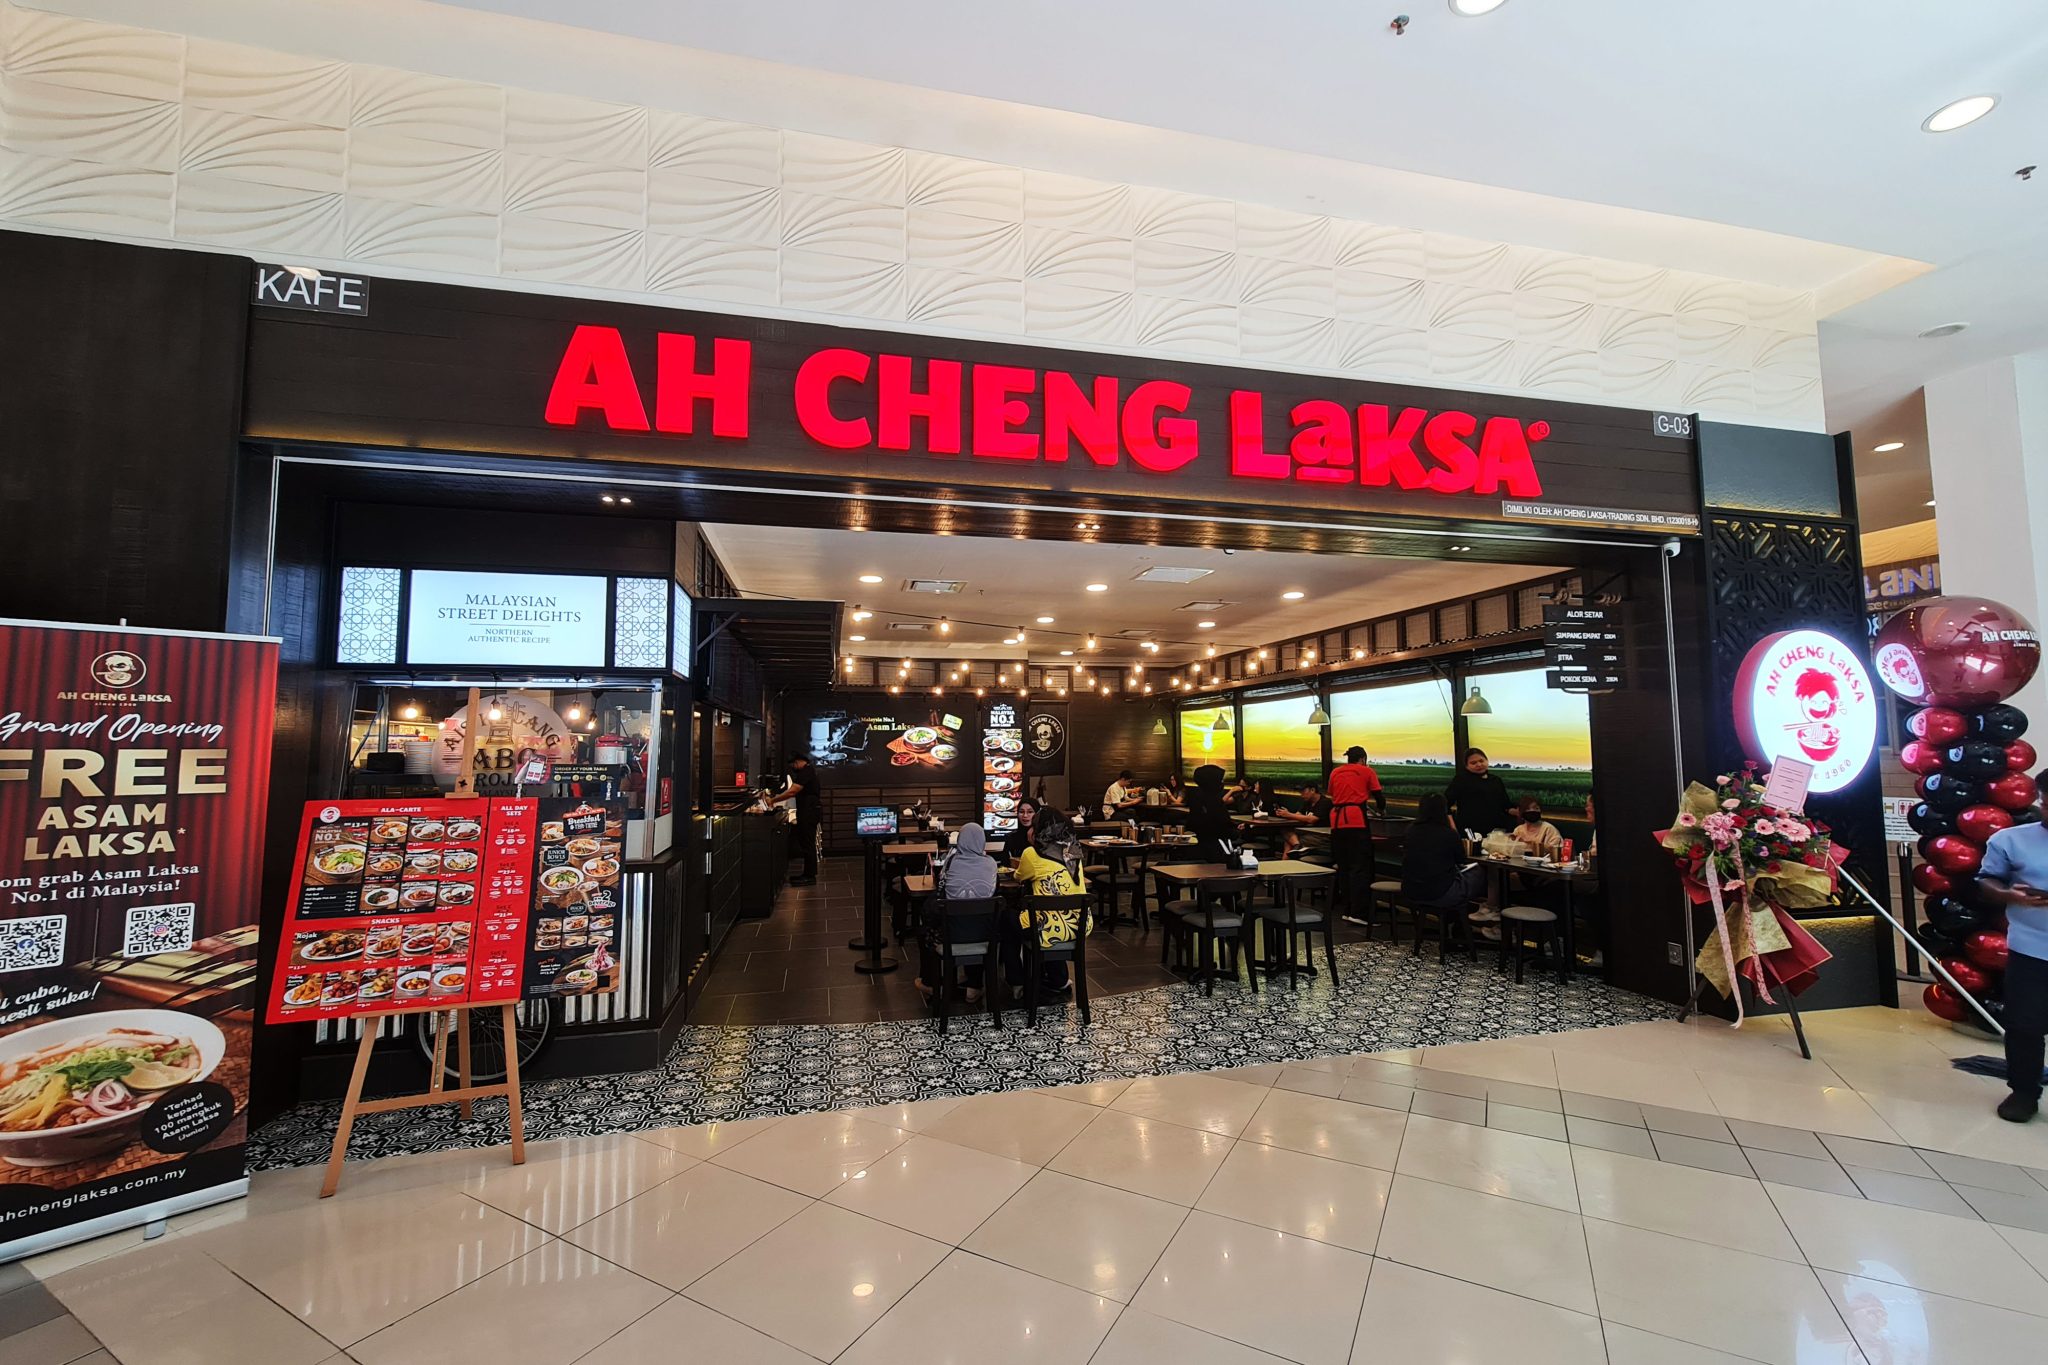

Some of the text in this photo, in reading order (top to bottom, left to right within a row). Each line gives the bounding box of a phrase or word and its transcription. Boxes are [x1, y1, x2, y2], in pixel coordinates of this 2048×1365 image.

[257, 268, 362, 311] KAFE
[545, 325, 751, 438] AH
[795, 348, 1198, 472] CHENG
[1657, 415, 1690, 435] G-03
[1506, 504, 1532, 514] DIMILIKI
[1553, 508, 1563, 517] AH
[1563, 508, 1586, 518] CHENG
[465, 594, 557, 608] MALAYSIAN
[438, 607, 582, 622] STREET DELIGHTS
[1566, 610, 1604, 619] ALOR SETAR
[485, 628, 533, 636] NORTHERN
[1555, 632, 1582, 640] SIMPANG
[1583, 632, 1601, 640] EMPAT
[1982, 631, 2000, 643] AH
[2000, 630, 2031, 641] CHENG
[467, 635, 551, 644] AUTHENTIC RECIPE
[1557, 654, 1574, 662] JITRA
[1765, 669, 1783, 697] AH
[1779, 645, 1825, 670] CHENG
[1560, 675, 1581, 683] POKOK
[57, 691, 78, 700] AH
[81, 691, 127, 701] CHENG
[990, 714, 1016, 725] NO.1
[0, 712, 224, 743] Grand Opening
[867, 723, 890, 731] Asam
[1824, 759, 1853, 780] 1960
[37, 802, 167, 830] ASAM
[567, 813, 602, 825] Breakfast
[315, 833, 341, 841] NO.1
[0, 863, 200, 889] om grab Asam Laksa
[11, 879, 181, 904] No.1 di Malaysia!
[371, 917, 401, 926] SNACKS
[15, 984, 68, 1005] cuba,
[46, 981, 101, 1010] suka!
[154, 1101, 222, 1134] 100 mangkuk
[167, 1101, 205, 1120] kepada
[162, 1111, 220, 1140] Asam Laksa
